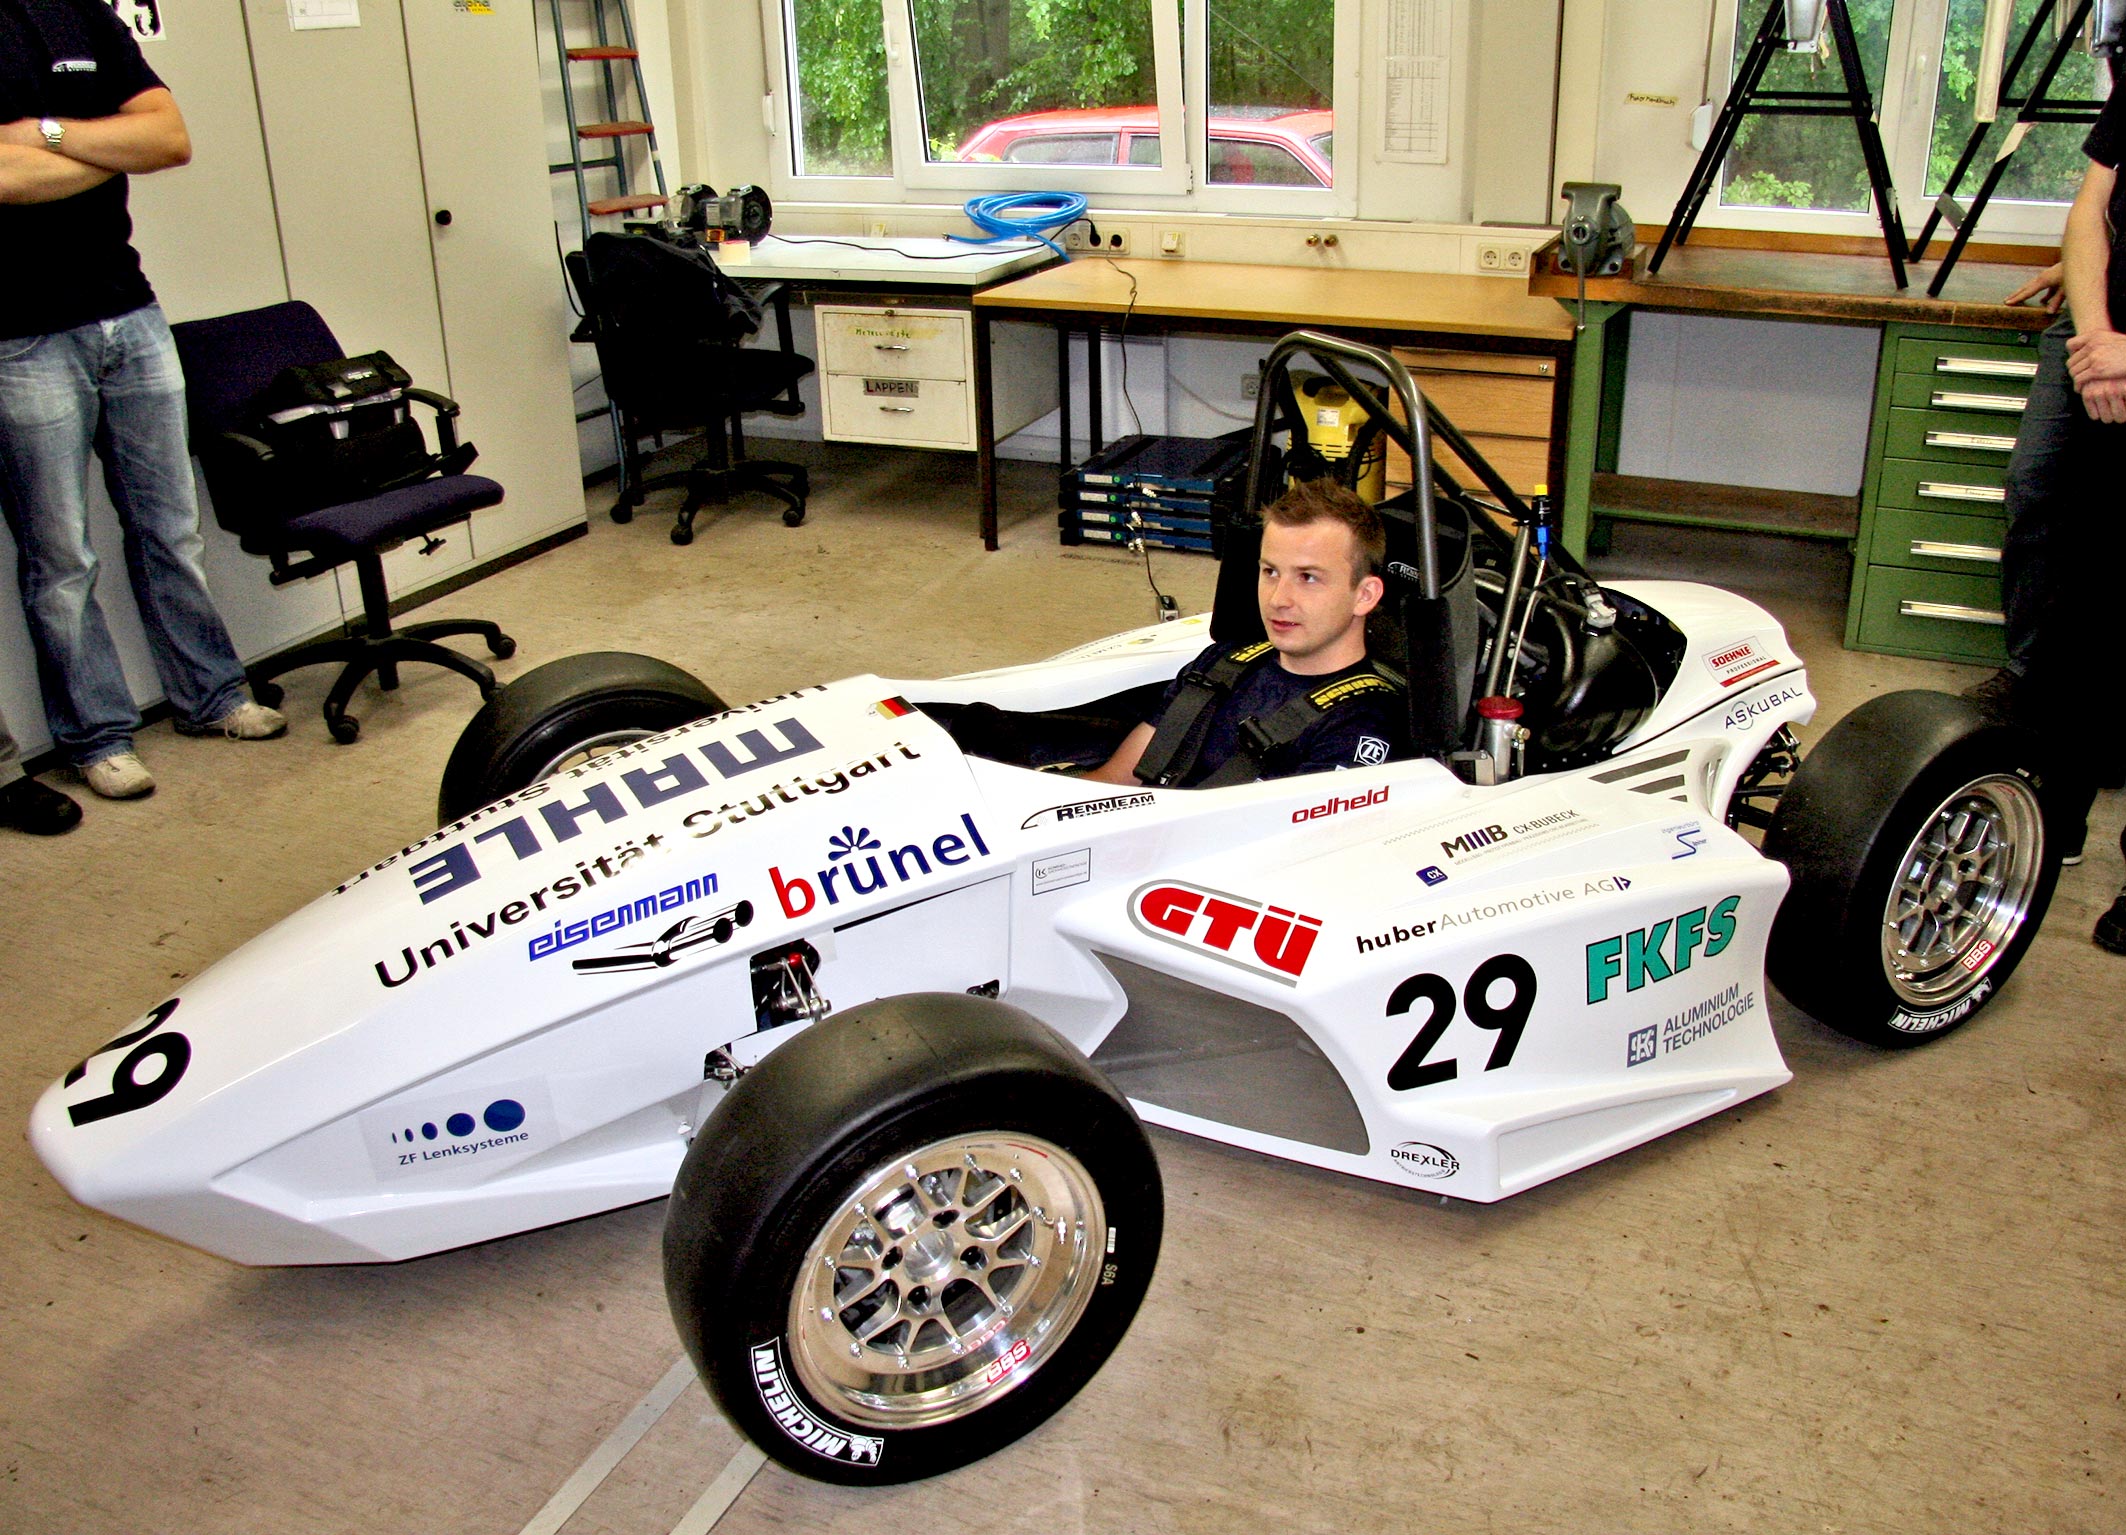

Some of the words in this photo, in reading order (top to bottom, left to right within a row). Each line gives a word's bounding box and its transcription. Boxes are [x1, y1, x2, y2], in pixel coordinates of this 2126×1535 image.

[866, 380, 914, 393] LAPPEN
[1711, 646, 1752, 668] SOEHNLE
[1726, 655, 1767, 674] PROFESSIONAL
[1724, 687, 1803, 729] ASKUBAL
[408, 717, 826, 906] MAHLE
[1291, 785, 1390, 824] oelheld
[374, 833, 672, 989] Universität
[681, 740, 922, 839] Stuttgart
[1584, 879, 1615, 897] AG
[529, 872, 719, 962] eisenmann
[1140, 887, 1323, 977] GTÜ
[1586, 895, 1741, 1005] FKFS
[1963, 940, 1991, 970] BBS
[1385, 953, 1538, 1092] 29
[1663, 982, 1739, 1036] ALUMINIUM
[1663, 992, 1754, 1053] TECHNOLOGIE
[1891, 999, 1971, 1031] MICHELIN
[64, 997, 192, 1128] 29
[398, 1153, 418, 1165] ZF
[423, 1132, 529, 1161] Lenksysteme
[1391, 1149, 1460, 1170] DREXLER
[1101, 1263, 1118, 1286] S6A
[987, 1340, 1029, 1381] BBS
[755, 1349, 848, 1457] MICHELIN
